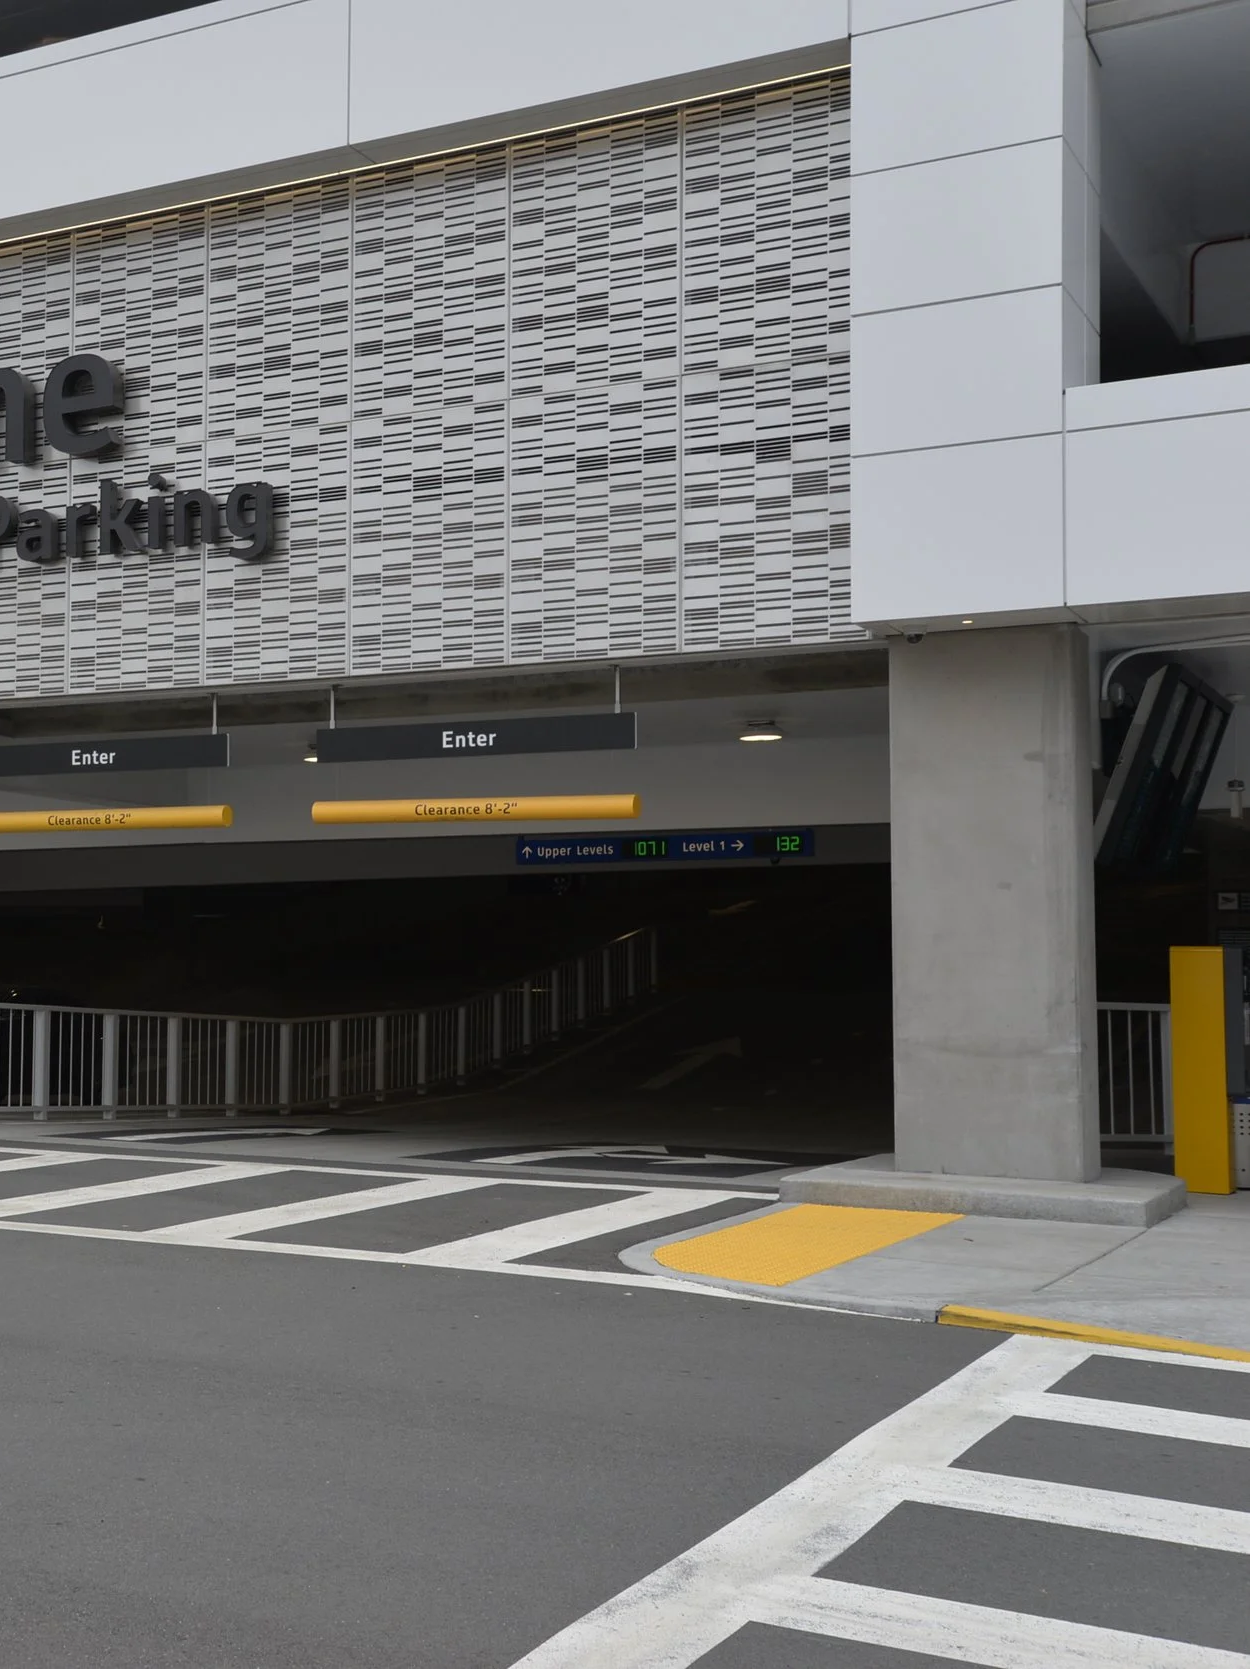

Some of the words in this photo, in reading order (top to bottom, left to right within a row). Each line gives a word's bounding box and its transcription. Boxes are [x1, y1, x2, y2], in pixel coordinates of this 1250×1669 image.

[442, 730, 497, 748] Enter
[71, 749, 116, 766] Enter
[414, 804, 480, 816] Clearance
[484, 802, 518, 815] 8'-2"
[47, 815, 101, 826] Clearance
[682, 840, 715, 853] Level
[719, 840, 725, 851] 1
[776, 836, 800, 851] 132
[537, 845, 571, 859] Upper
[576, 844, 614, 856] Levels
